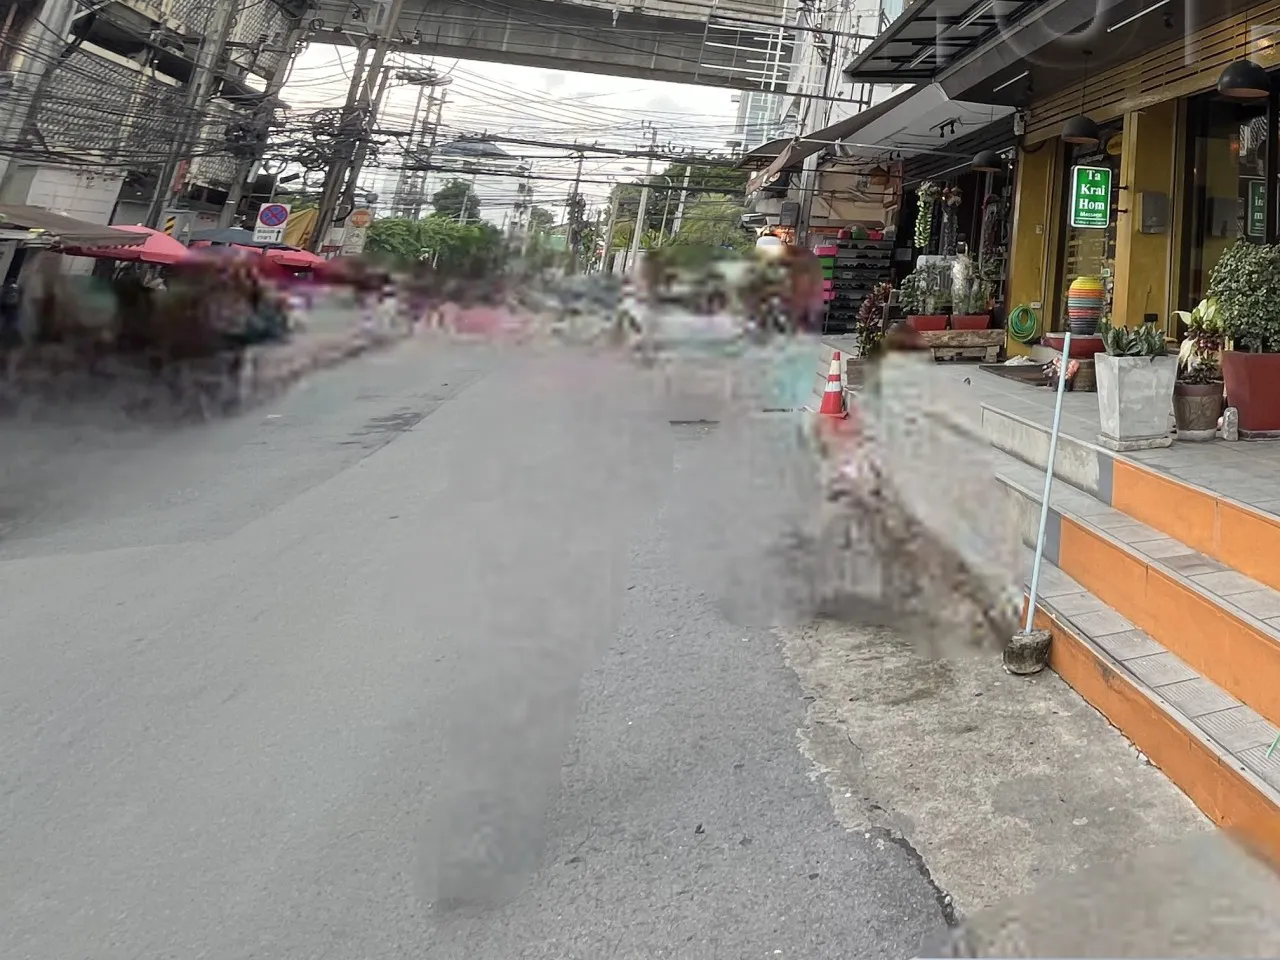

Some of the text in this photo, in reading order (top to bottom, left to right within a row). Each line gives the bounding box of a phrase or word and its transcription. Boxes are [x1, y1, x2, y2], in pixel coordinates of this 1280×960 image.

[1087, 170, 1101, 180] Ta
[1081, 184, 1105, 195] Krai
[1079, 198, 1105, 210] Hom
